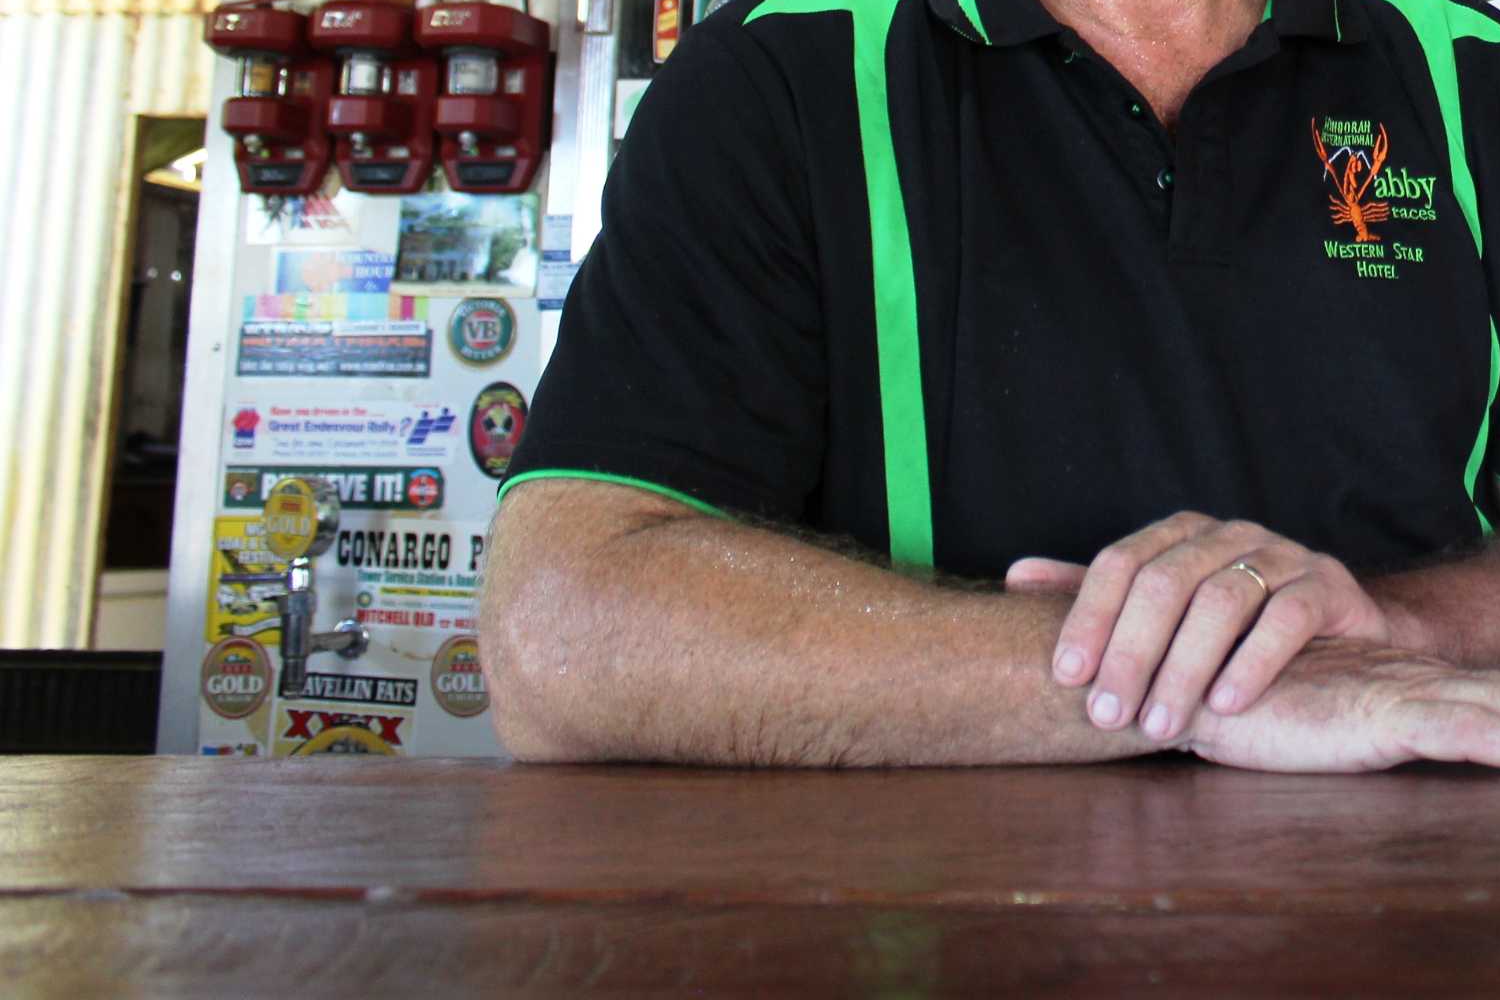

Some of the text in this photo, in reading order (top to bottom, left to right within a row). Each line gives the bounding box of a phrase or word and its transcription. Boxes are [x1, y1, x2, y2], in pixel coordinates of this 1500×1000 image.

[1391, 206, 1437, 221] races
[1324, 239, 1424, 263] WESTERN STAR
[1356, 260, 1399, 280] HOTEL
[466, 318, 499, 342] VB
[269, 420, 397, 436] Great Endeavour Rally
[372, 472, 404, 502] IT!
[336, 530, 452, 571] CONARGO
[206, 674, 264, 695] GOLD
